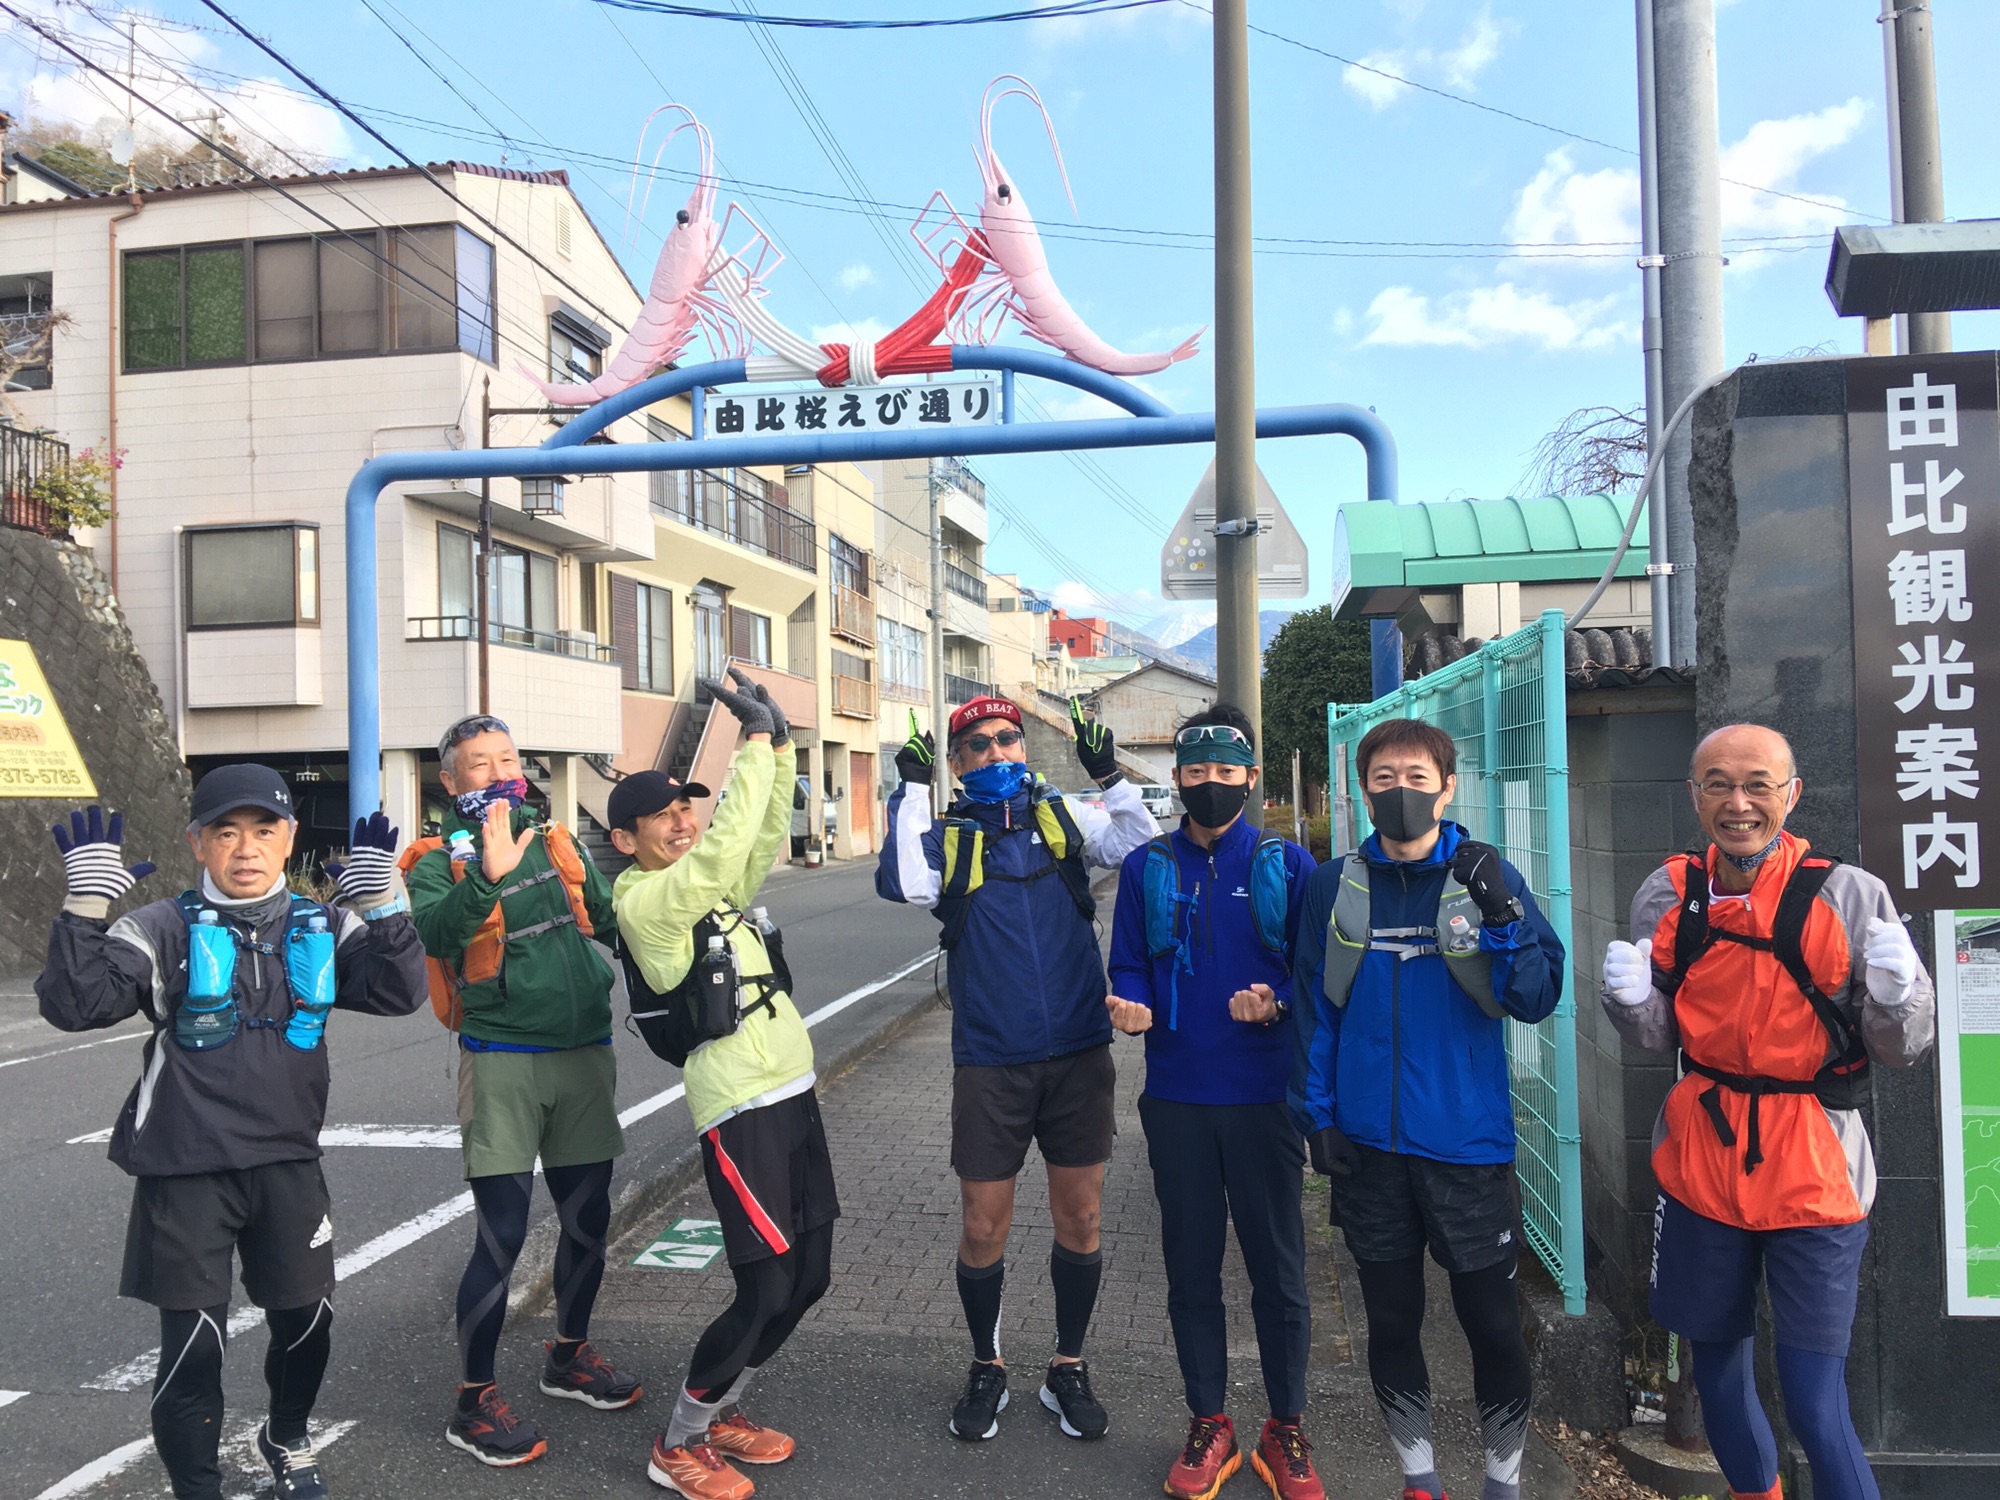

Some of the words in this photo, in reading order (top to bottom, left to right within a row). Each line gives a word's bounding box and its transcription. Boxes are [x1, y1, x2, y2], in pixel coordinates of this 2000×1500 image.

[716, 387, 989, 433] 由比桜えび通り
[1886, 373, 1980, 888] 由比観光案内
[964, 707, 979, 720] MY
[986, 703, 1014, 714] BEAT
[1649, 1194, 1667, 1289] KELME
